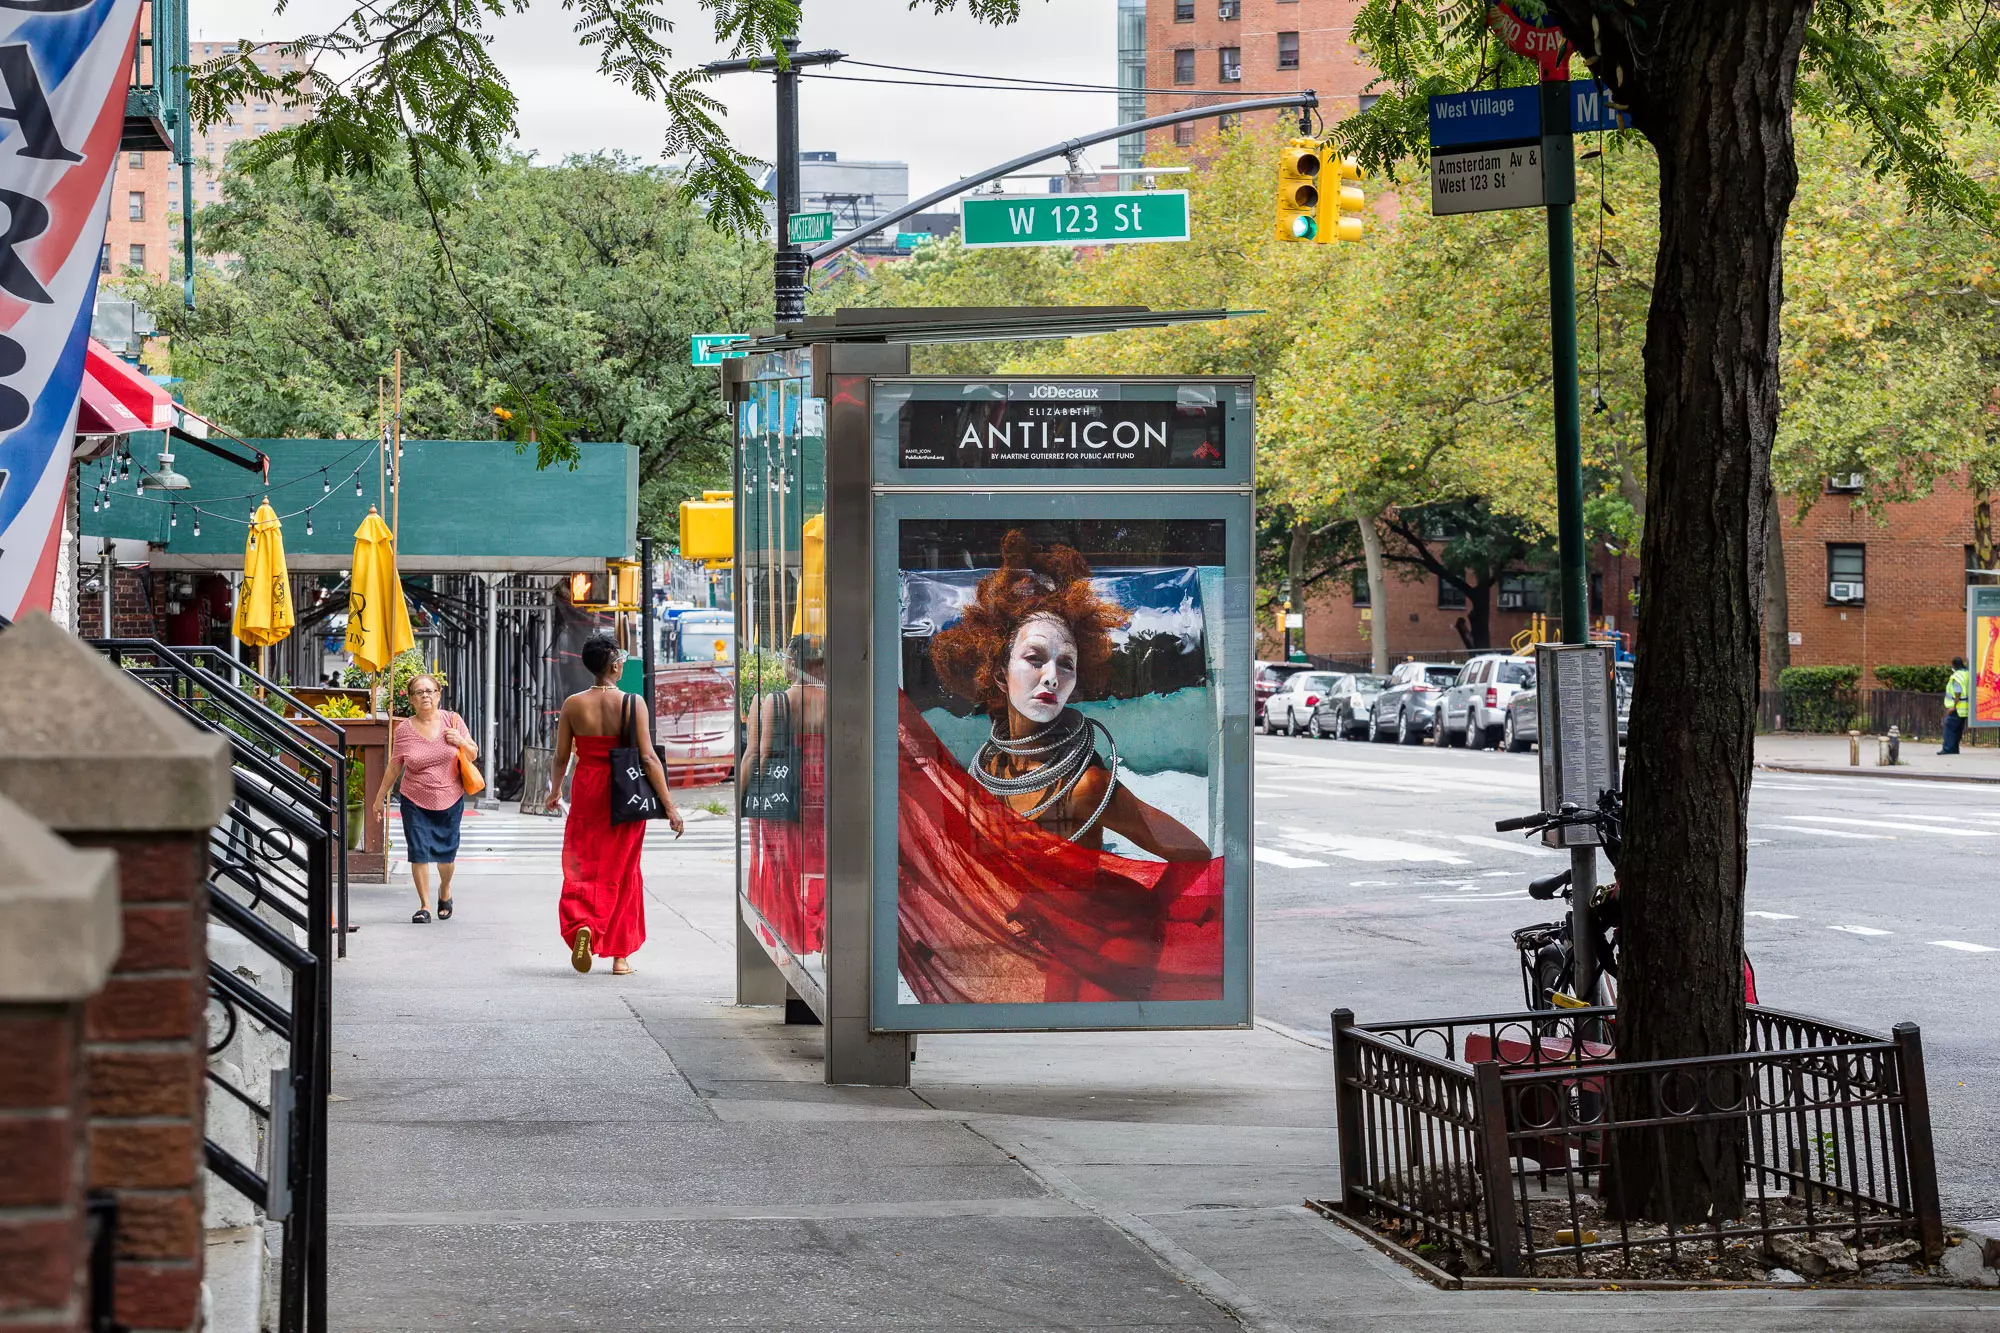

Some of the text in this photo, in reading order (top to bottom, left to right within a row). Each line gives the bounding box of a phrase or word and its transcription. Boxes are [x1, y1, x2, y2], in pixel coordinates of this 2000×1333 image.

[1435, 97, 1515, 119] West Village
[1438, 150, 1537, 175] Amsterdam Av &
[1439, 172, 1506, 194] West 123 St
[790, 215, 825, 241] AMSTERDAM
[1008, 202, 1143, 235] W 123 St
[697, 339, 711, 361] W
[1029, 385, 1099, 399] JCDecaux
[1029, 407, 1090, 416] ELIZABETH
[958, 421, 1167, 449] ANTI-ICON
[627, 793, 659, 812] FAI
